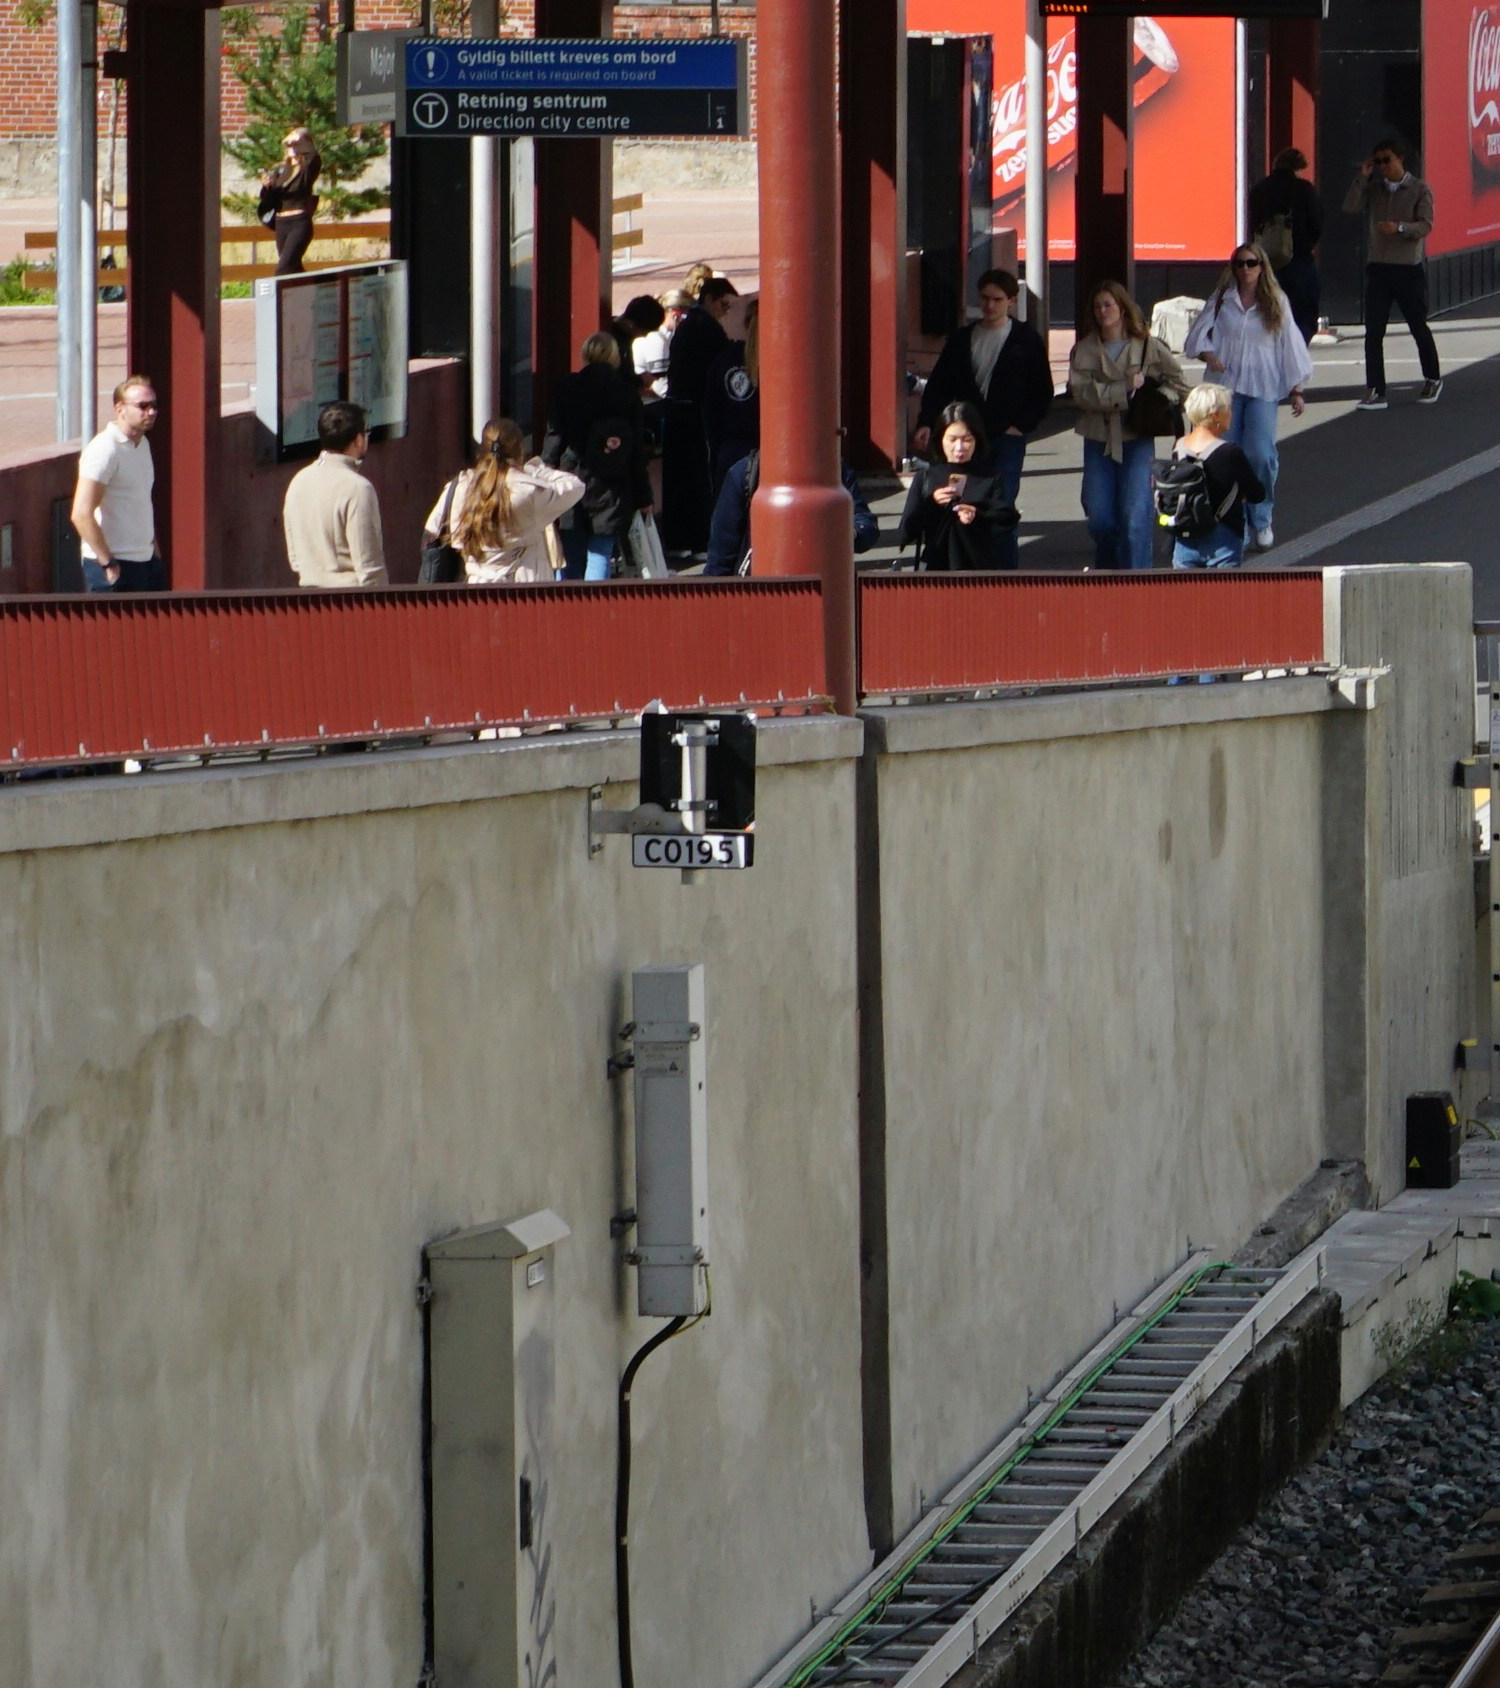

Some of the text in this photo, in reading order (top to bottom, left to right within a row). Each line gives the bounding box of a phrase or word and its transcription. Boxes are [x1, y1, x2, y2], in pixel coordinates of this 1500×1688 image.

[458, 49, 677, 66] Gyldig billett kreves om bord
[458, 69, 656, 83] A valid ticket is required on board
[458, 93, 607, 111] Retning sentrum
[458, 114, 631, 132] Direction city centre
[716, 118, 725, 129] 1
